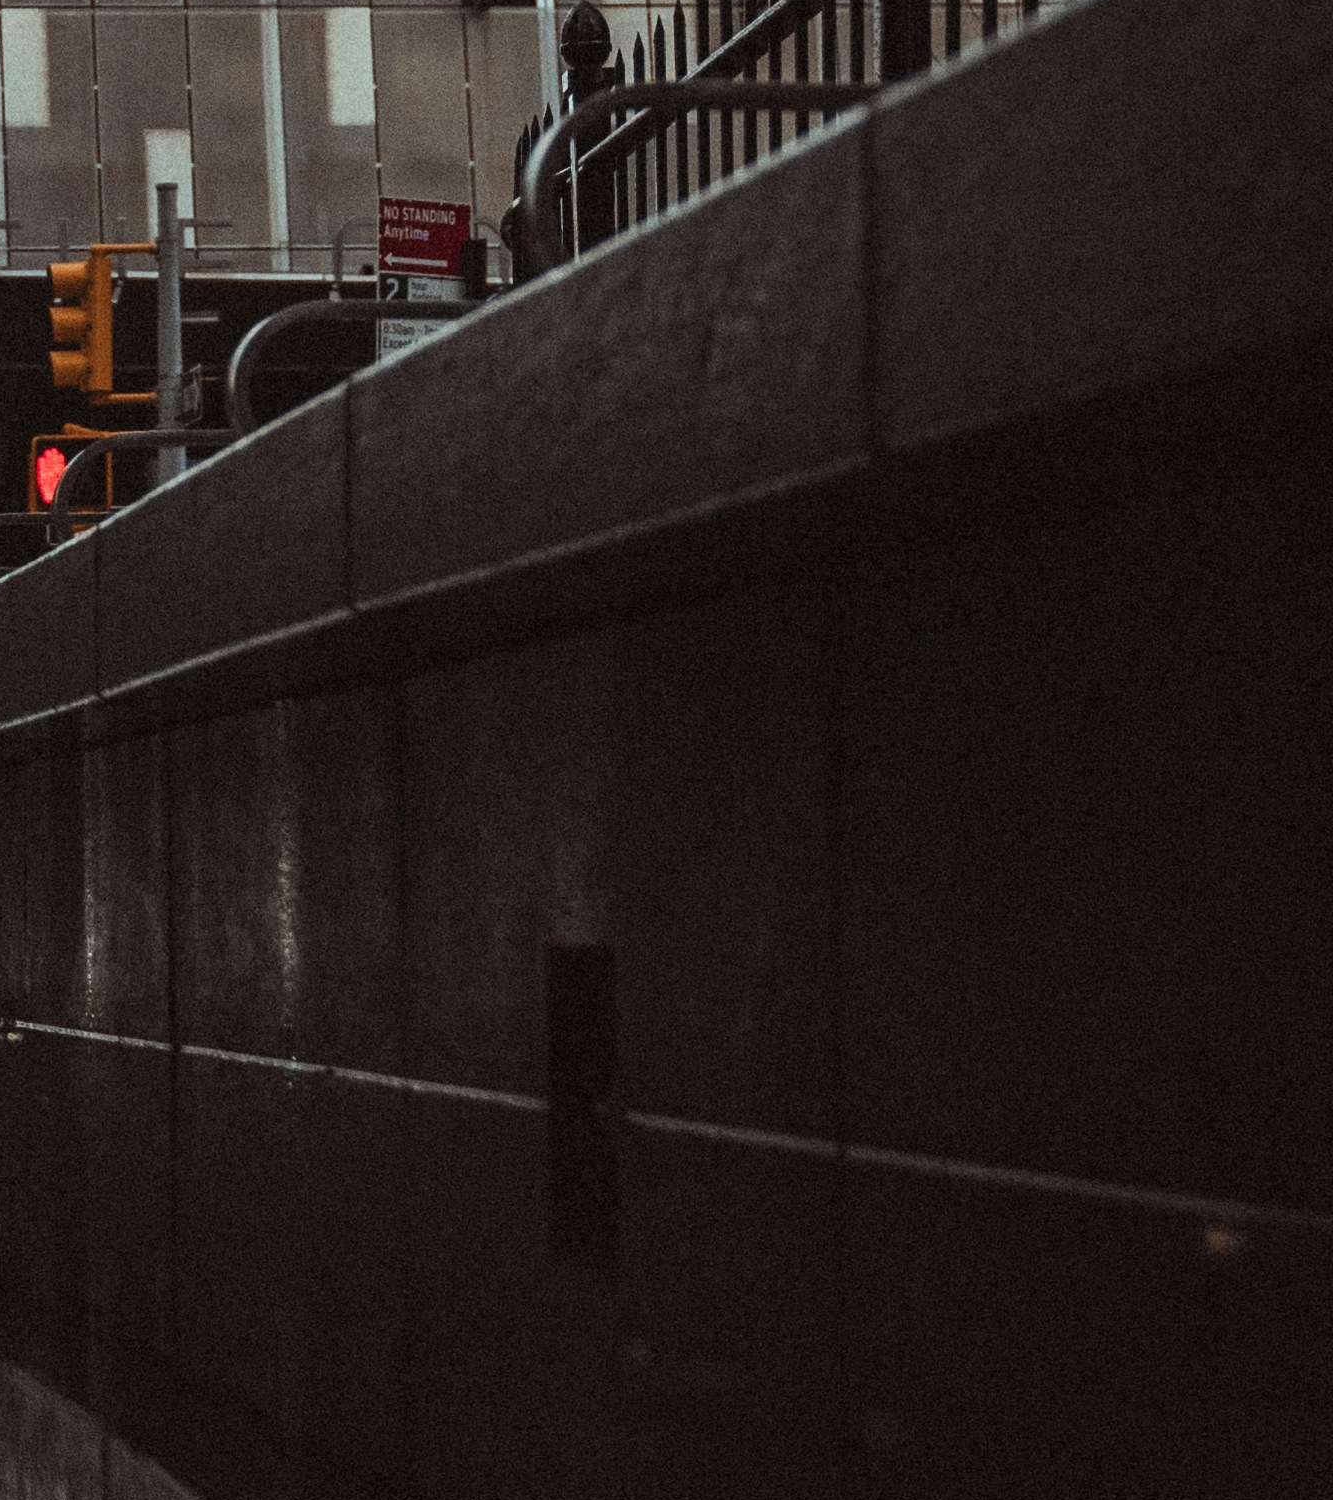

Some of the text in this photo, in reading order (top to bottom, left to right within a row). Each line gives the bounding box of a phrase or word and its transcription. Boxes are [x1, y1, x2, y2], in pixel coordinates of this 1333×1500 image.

[383, 206, 456, 225] NO STANDING
[383, 223, 430, 241] Anytime
